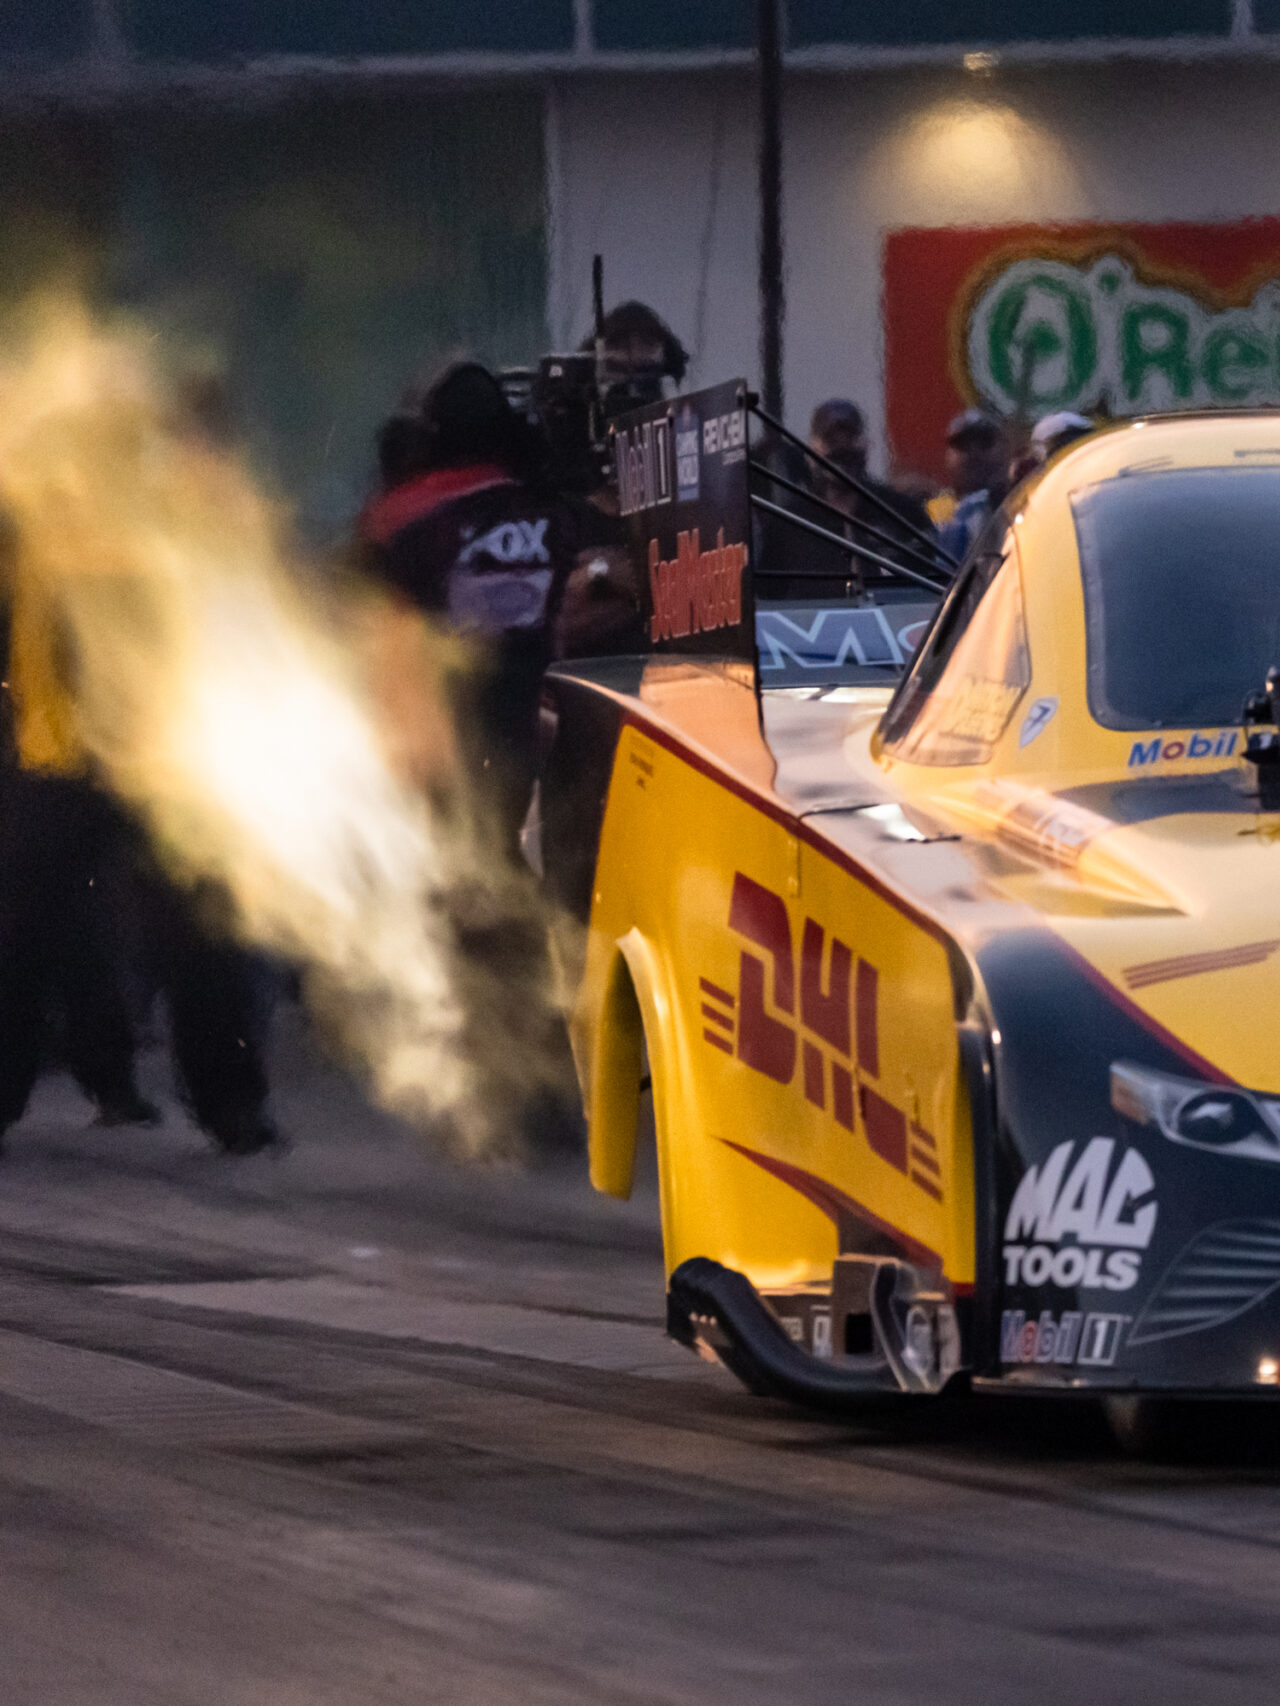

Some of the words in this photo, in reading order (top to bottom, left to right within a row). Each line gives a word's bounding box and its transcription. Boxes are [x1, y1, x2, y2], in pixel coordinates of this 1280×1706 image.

[1127, 732, 1239, 767] Mobil
[728, 870, 909, 1178] DHL
[1004, 1136, 1159, 1249] MAC
[1002, 1244, 1143, 1292] TOOLS
[1000, 1308, 1083, 1365] Mobil
